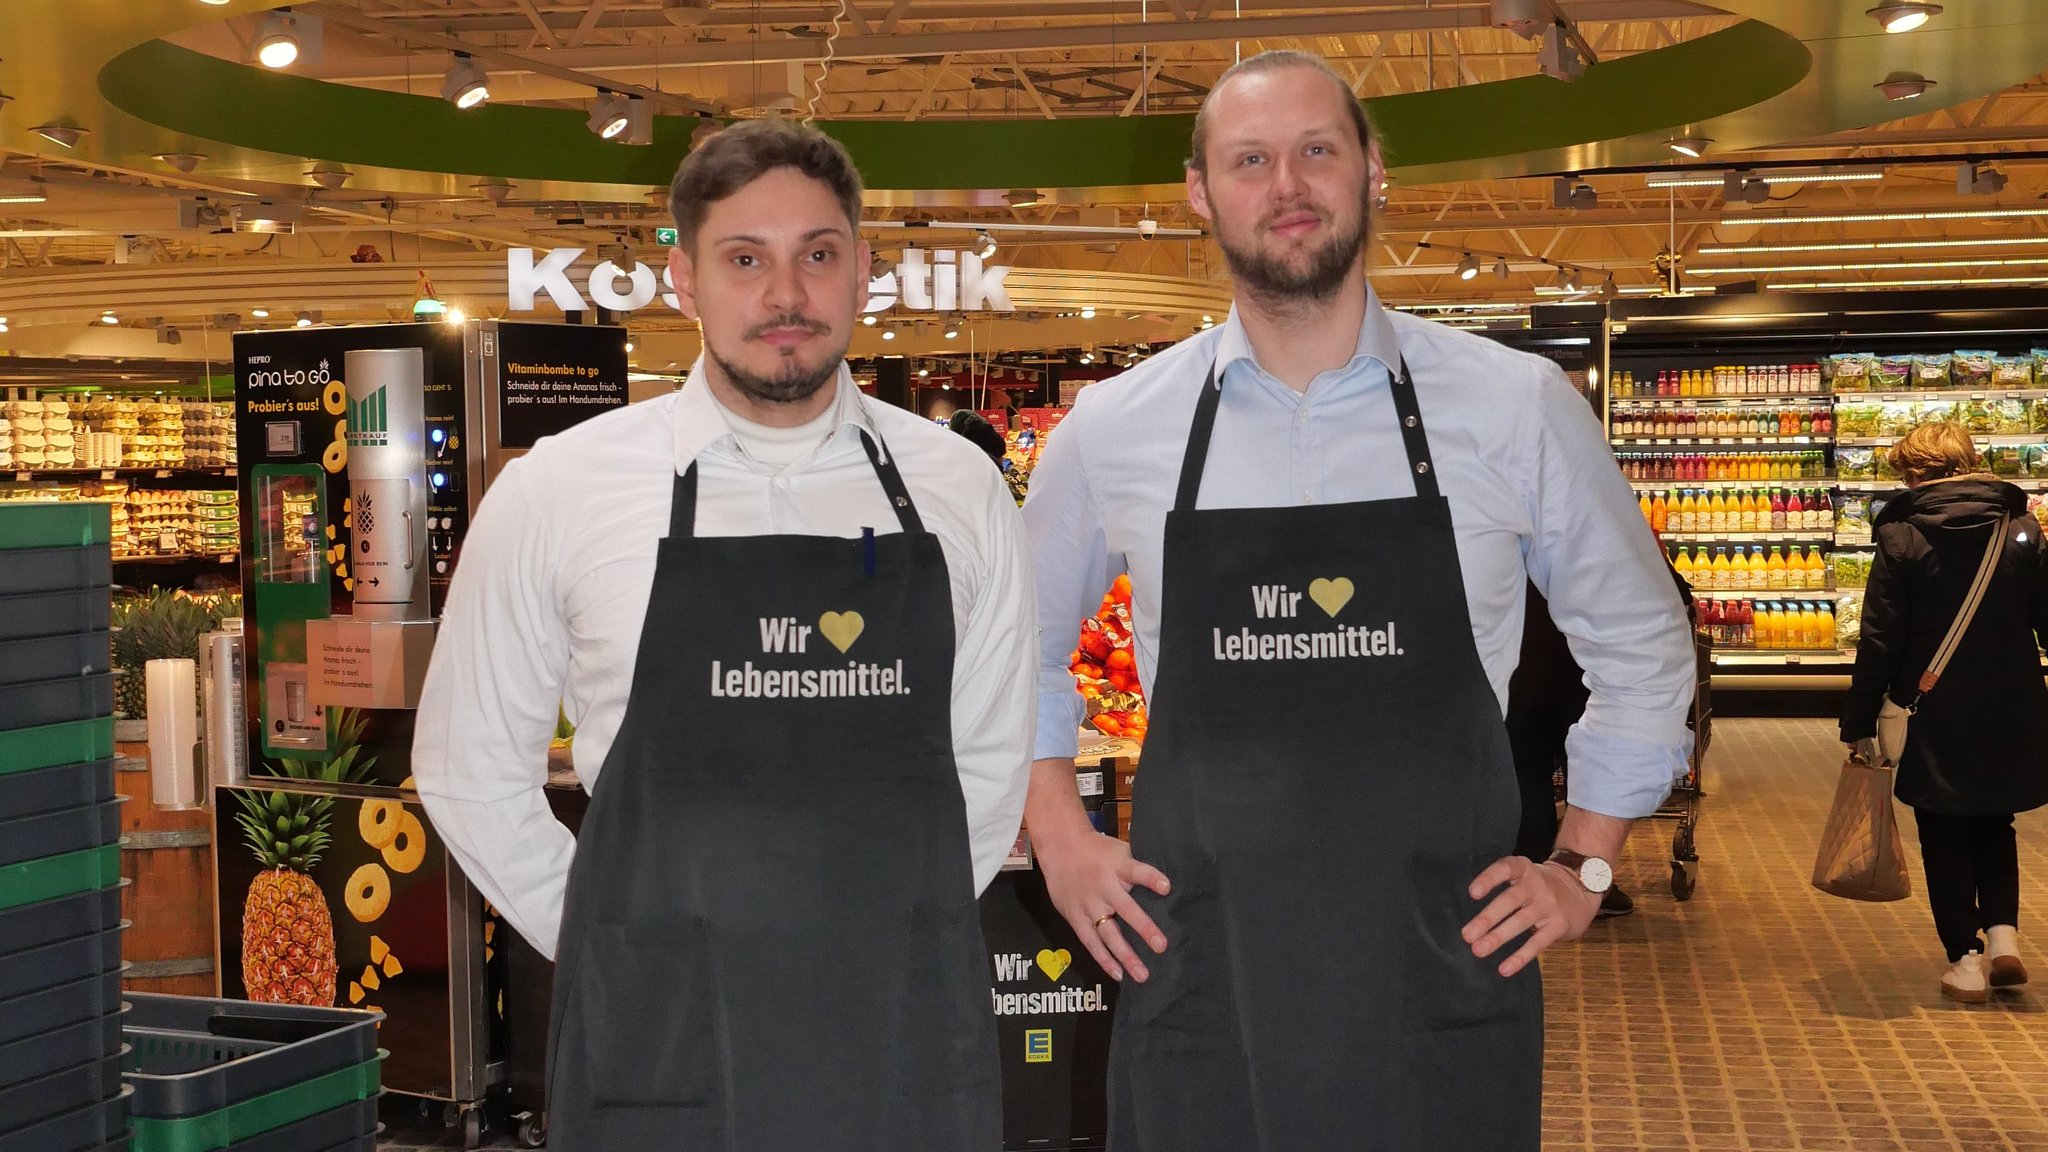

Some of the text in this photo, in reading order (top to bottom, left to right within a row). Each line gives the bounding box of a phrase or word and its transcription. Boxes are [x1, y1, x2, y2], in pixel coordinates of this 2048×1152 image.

[508, 248, 1016, 312] Kotik
[248, 355, 271, 364] HEPRO
[508, 362, 599, 378] Vitaminbombe to go
[507, 381, 540, 391] Schneide
[541, 381, 551, 391] dir
[552, 382, 572, 391] deine
[573, 382, 598, 392] Ananas
[600, 382, 617, 392] frisch
[542, 395, 557, 404] aus!
[569, 395, 624, 404] Handumdrehen.
[296, 397, 319, 412] aus!
[1252, 585, 1302, 618] Wir
[759, 617, 812, 653] Wir
[1213, 622, 1404, 661] Lebensmittel.
[711, 659, 911, 698] Lebensmittel.
[994, 953, 1032, 981] Wir
[991, 984, 1108, 1015] bensmittel.
